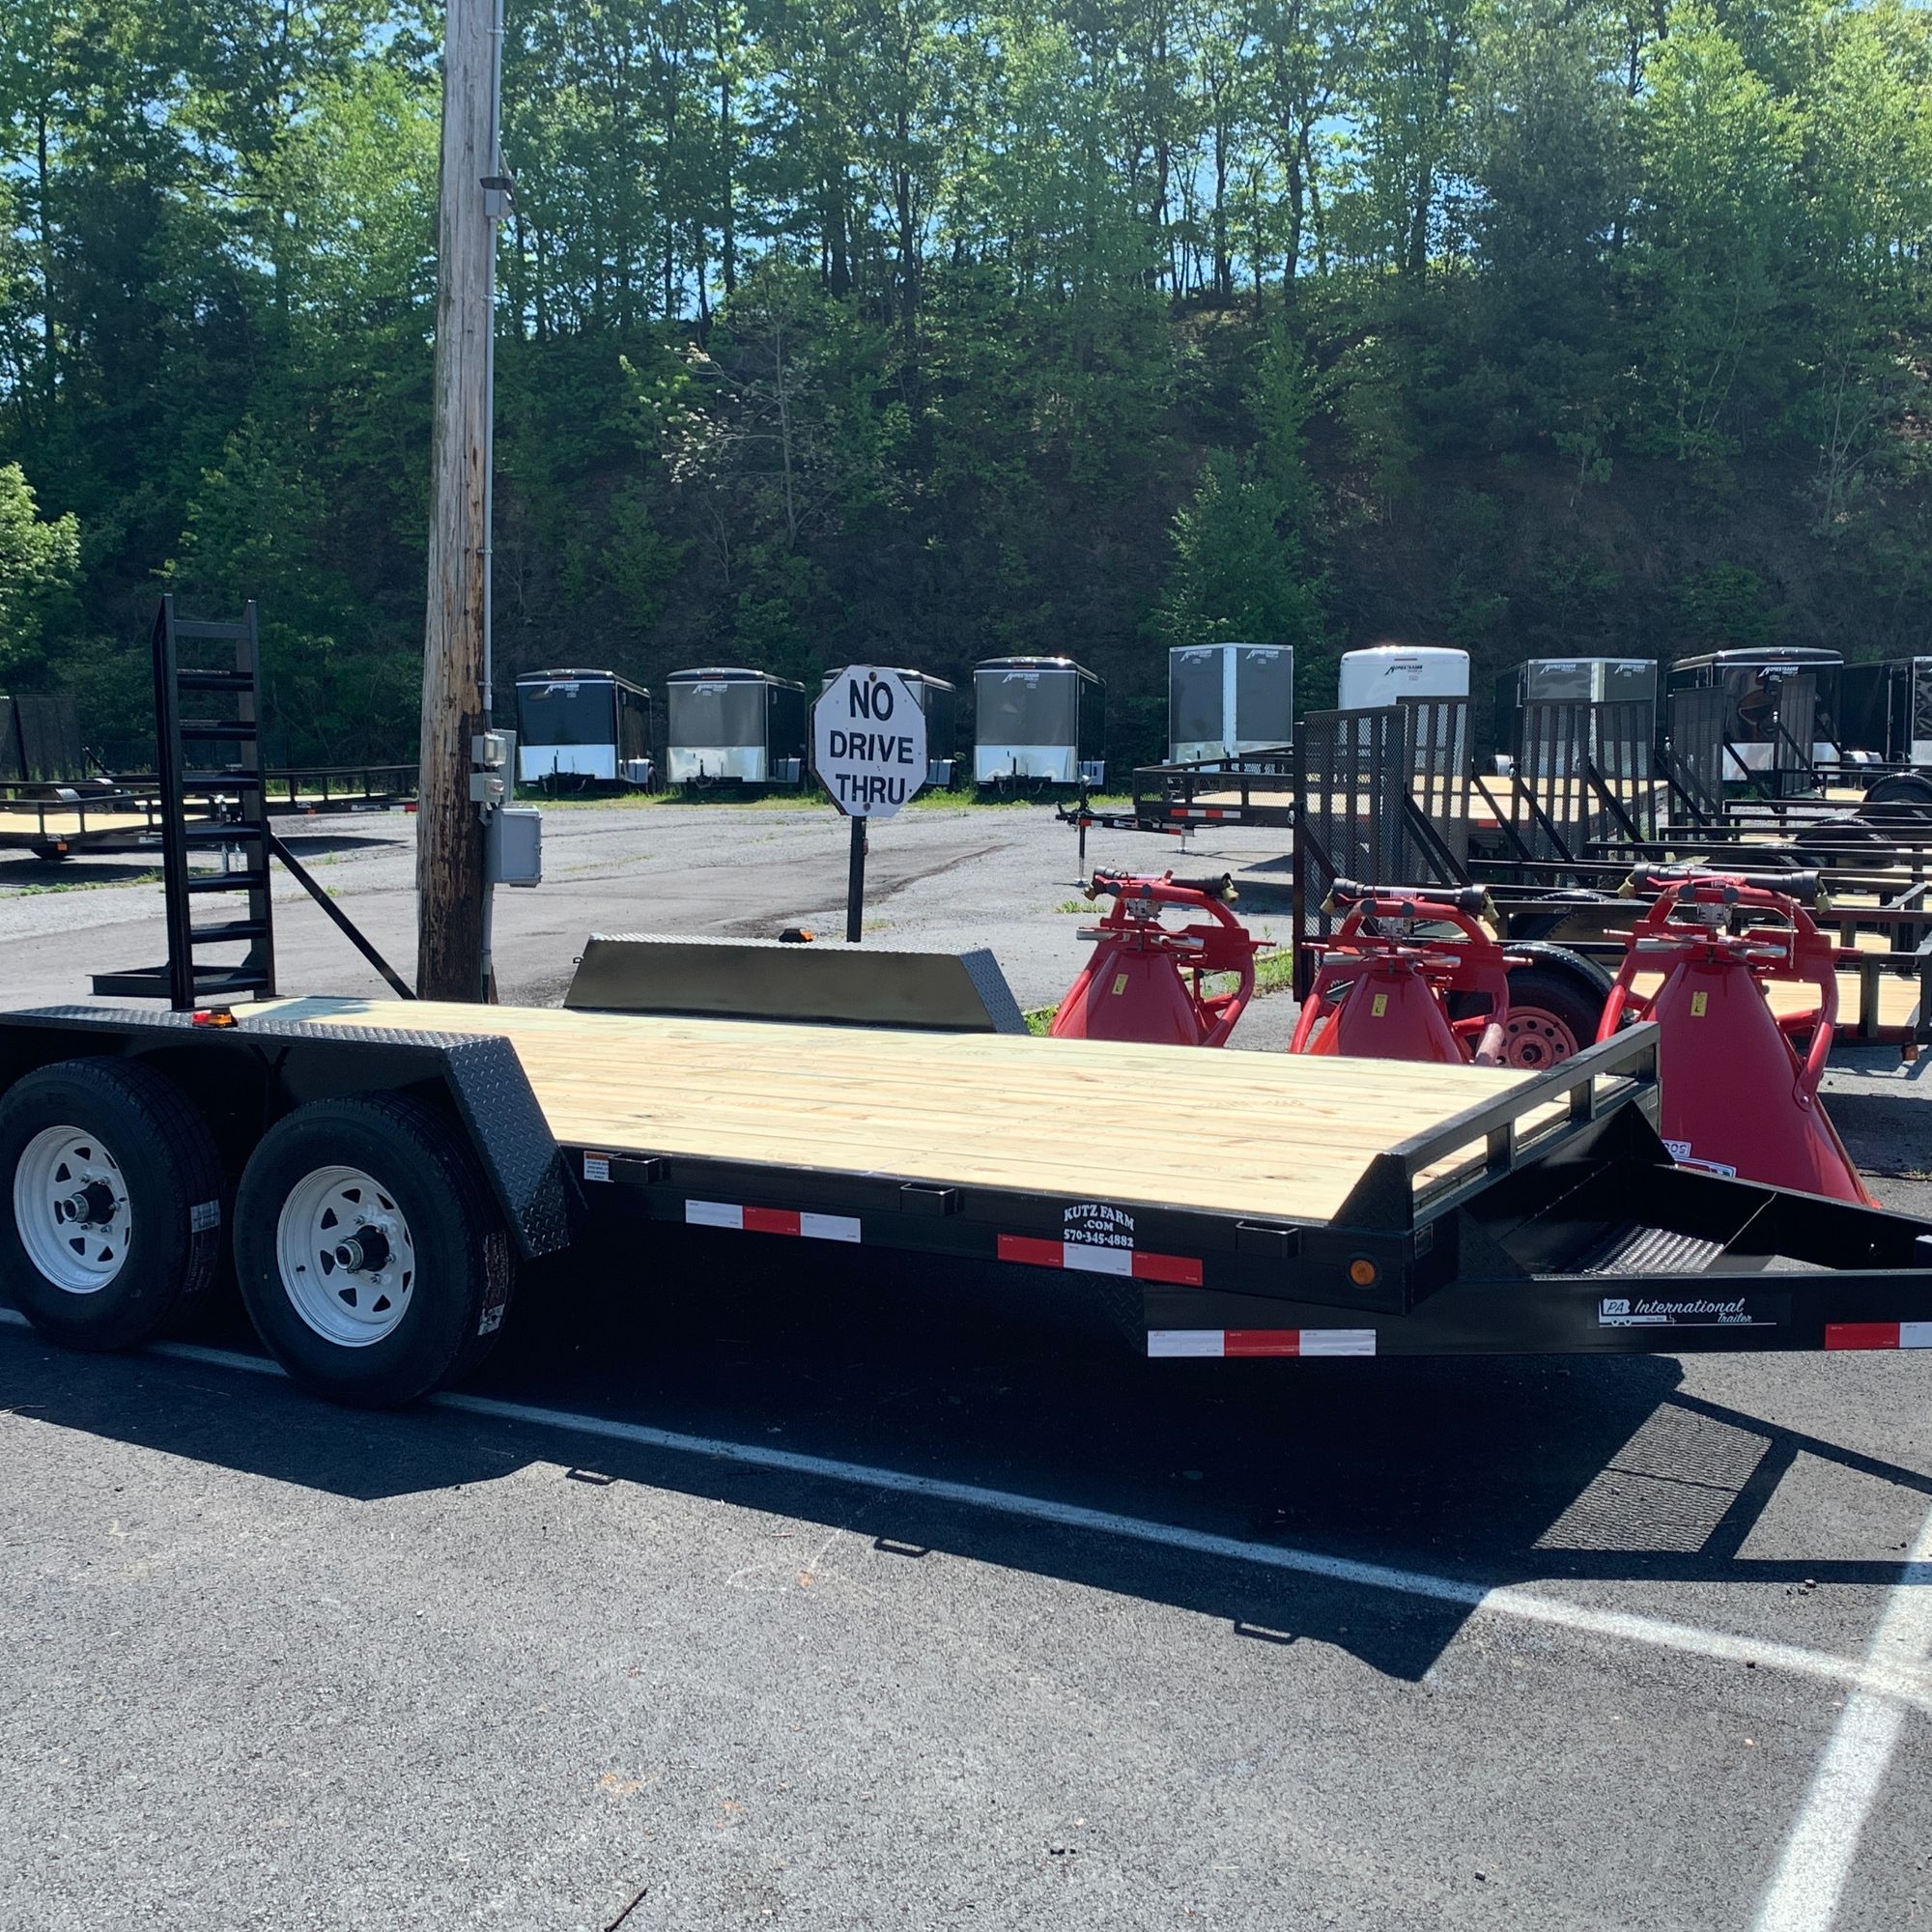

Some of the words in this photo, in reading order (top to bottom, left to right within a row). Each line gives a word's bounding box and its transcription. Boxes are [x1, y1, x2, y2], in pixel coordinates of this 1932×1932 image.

[850, 679, 894, 722] NO
[830, 730, 914, 764] DRIVE
[836, 774, 905, 805] THRU
[1064, 1205, 1098, 1222] KUTZ
[1100, 1205, 1135, 1232] FARM
[1083, 1219, 1114, 1232] .COM
[1606, 1301, 1624, 1314] PA
[1634, 1298, 1746, 1314] International
[1717, 1312, 1752, 1323] Trailer
